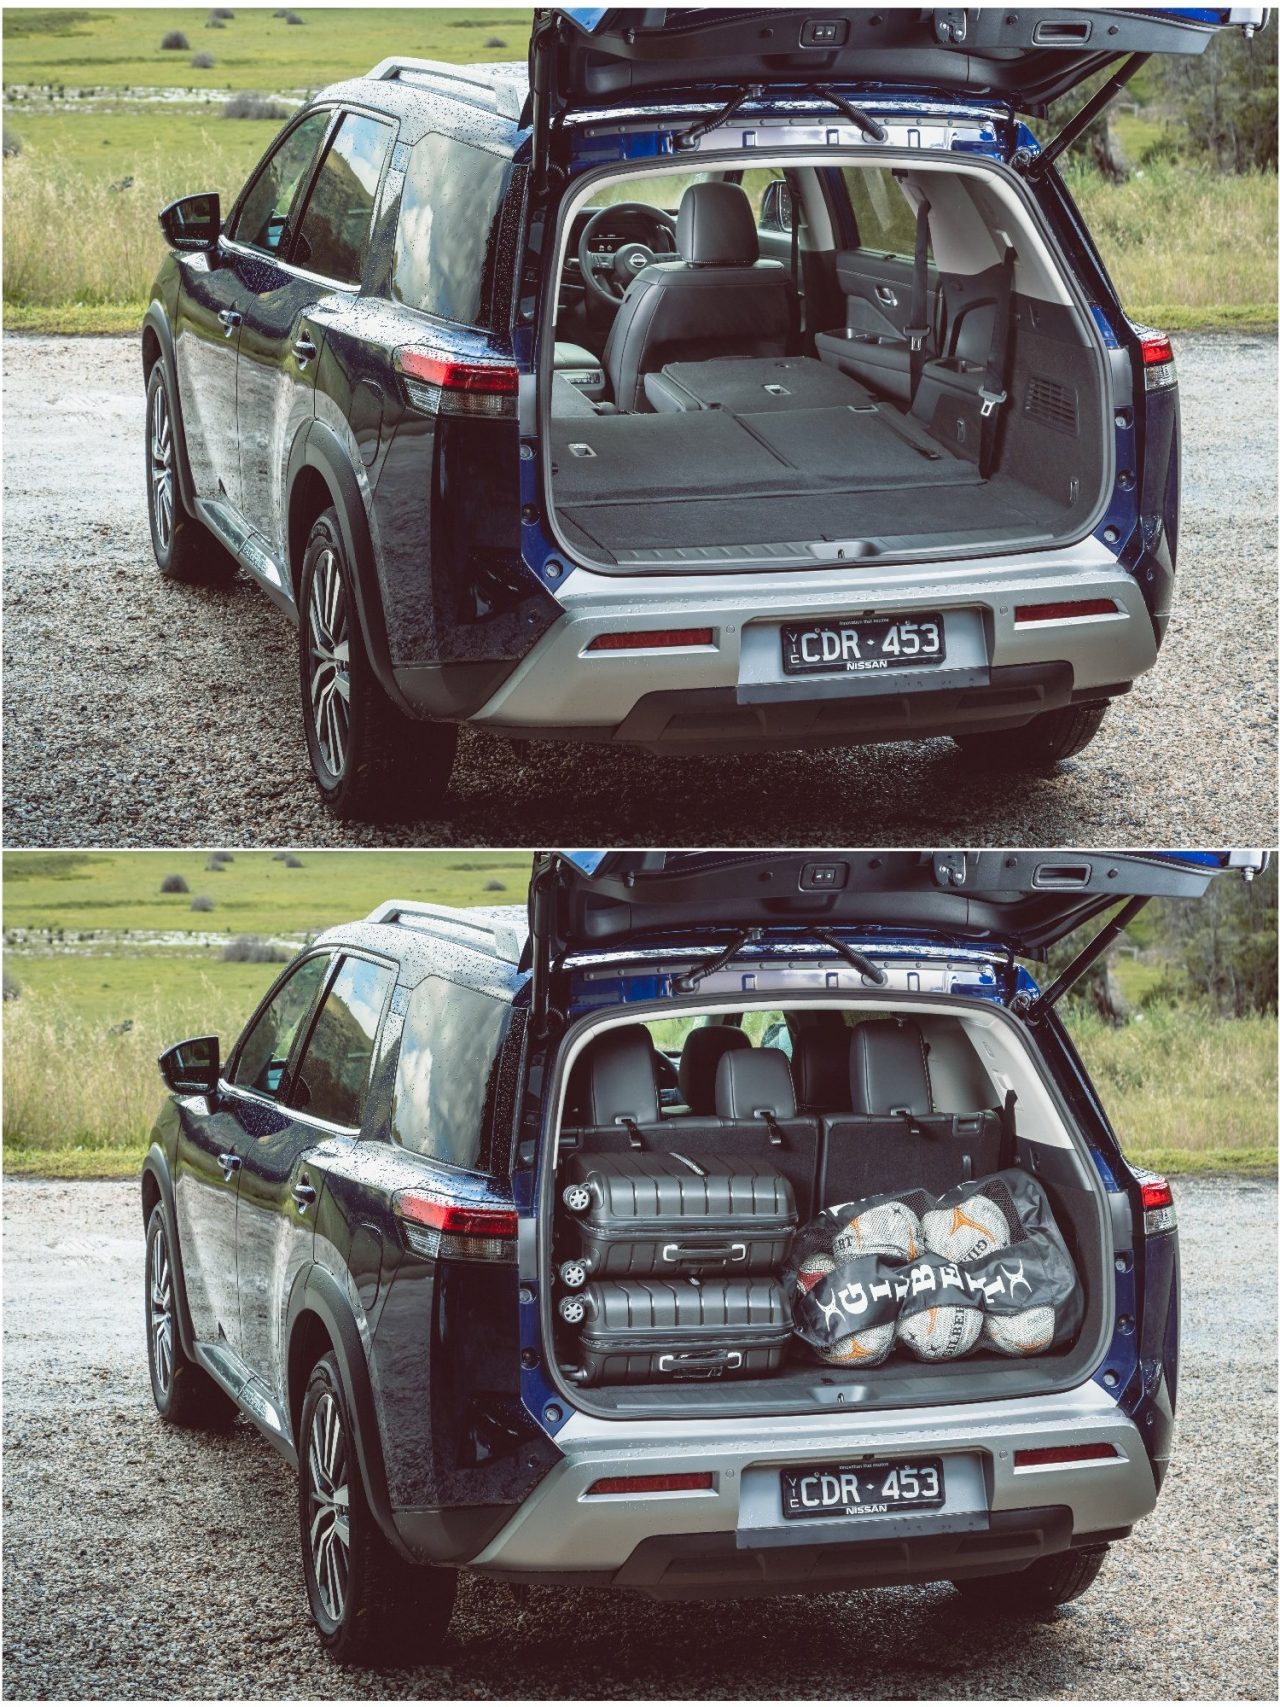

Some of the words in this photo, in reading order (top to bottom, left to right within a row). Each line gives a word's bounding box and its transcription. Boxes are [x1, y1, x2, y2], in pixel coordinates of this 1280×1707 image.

[788, 633, 800, 664] VIC
[801, 630, 861, 662] CDR
[881, 623, 940, 655] 453
[846, 660, 888, 671] NISSAN
[788, 1477, 800, 1508] VIC
[800, 1474, 861, 1507] CDR
[881, 1467, 939, 1500] 453
[846, 1504, 888, 1515] NISSAN
